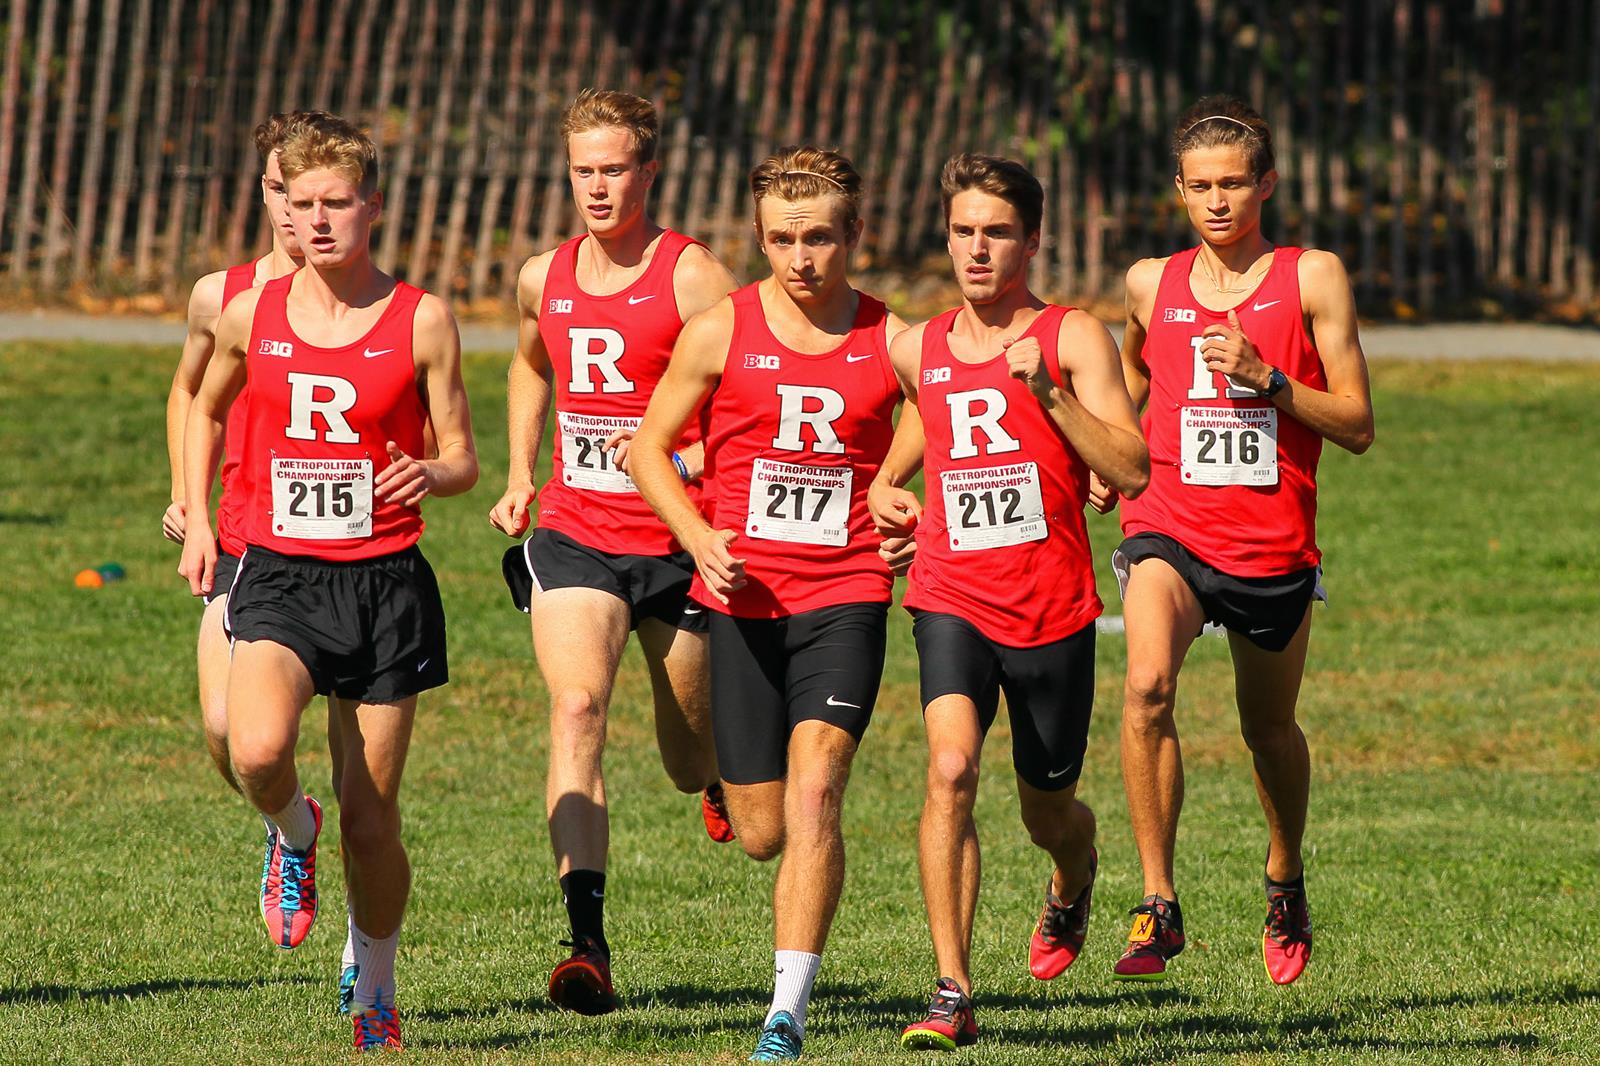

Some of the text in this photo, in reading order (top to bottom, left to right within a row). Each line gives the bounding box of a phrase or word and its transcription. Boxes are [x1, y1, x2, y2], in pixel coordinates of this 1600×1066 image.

[567, 327, 635, 393] R
[285, 371, 360, 444] R
[1189, 409, 1268, 419] METROPOLITAN
[567, 415, 638, 428] METROPOLITAN
[771, 383, 845, 454] R
[945, 387, 1020, 460] R
[1186, 419, 1271, 429] CHAMPIONSHIPS
[563, 425, 616, 437] CHAMPION
[575, 436, 620, 472] 21
[1197, 429, 1260, 465] 216
[279, 460, 362, 470] METROPOLITAN
[762, 462, 843, 478] METROPOLITAN
[948, 465, 1026, 481] METROPOLITAN
[276, 471, 366, 481] CHAMPIONSHIPS
[757, 472, 845, 489] CHAMPIONSHIPS
[946, 476, 1032, 493] CHAMPIONSHIPS
[288, 481, 354, 518] 215
[766, 484, 833, 522] 217
[958, 488, 1025, 529] 212
